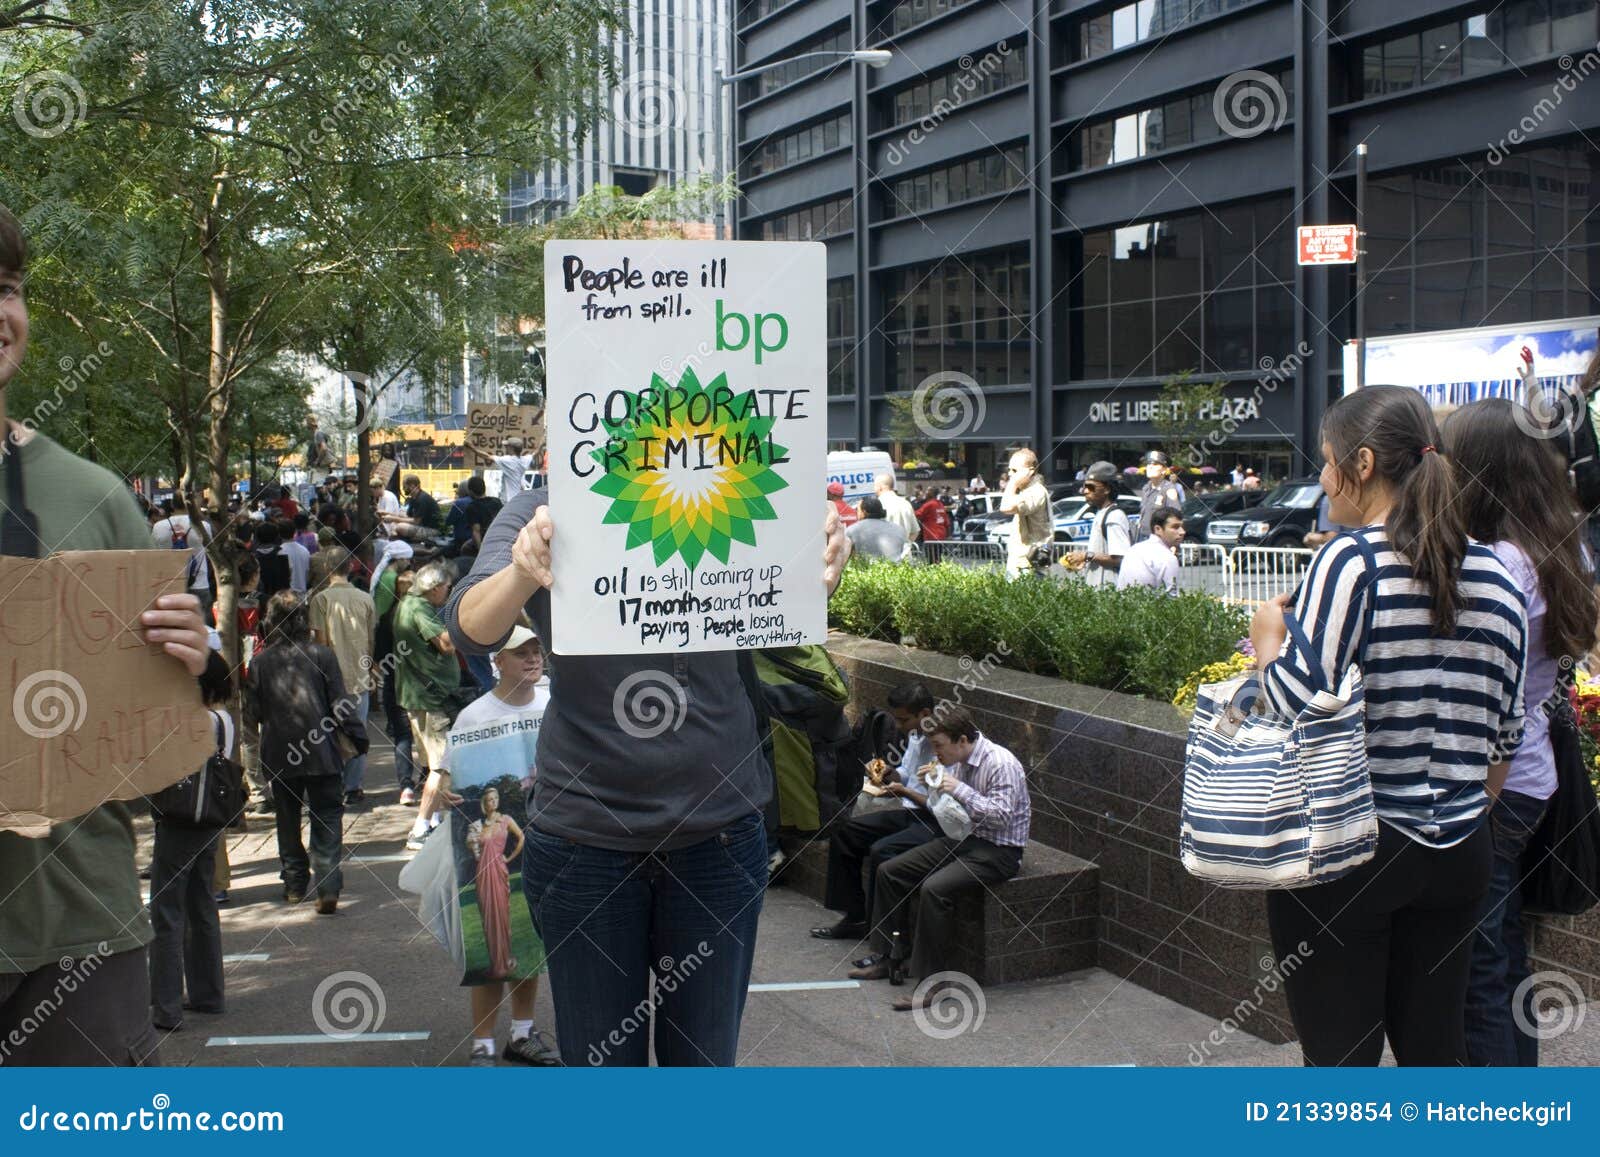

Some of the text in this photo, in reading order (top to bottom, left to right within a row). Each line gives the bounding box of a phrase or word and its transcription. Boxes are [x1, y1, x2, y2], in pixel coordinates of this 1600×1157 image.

[562, 255, 727, 297] People are ill
[581, 293, 692, 322] from spill.
[715, 299, 789, 365] bp
[470, 405, 522, 433] Google:
[569, 388, 811, 434] CORPORATE
[1089, 397, 1260, 422] ONE LIBET PLAZA
[472, 430, 536, 449] Jesu is
[570, 432, 790, 478] CRIMINAL
[826, 472, 874, 485] OLICE
[662, 561, 694, 591] still
[700, 567, 753, 596] coming
[619, 584, 783, 626] 17 months and not
[641, 620, 690, 647] paying
[750, 613, 784, 634] losing
[451, 722, 509, 746] PRESIDENT
